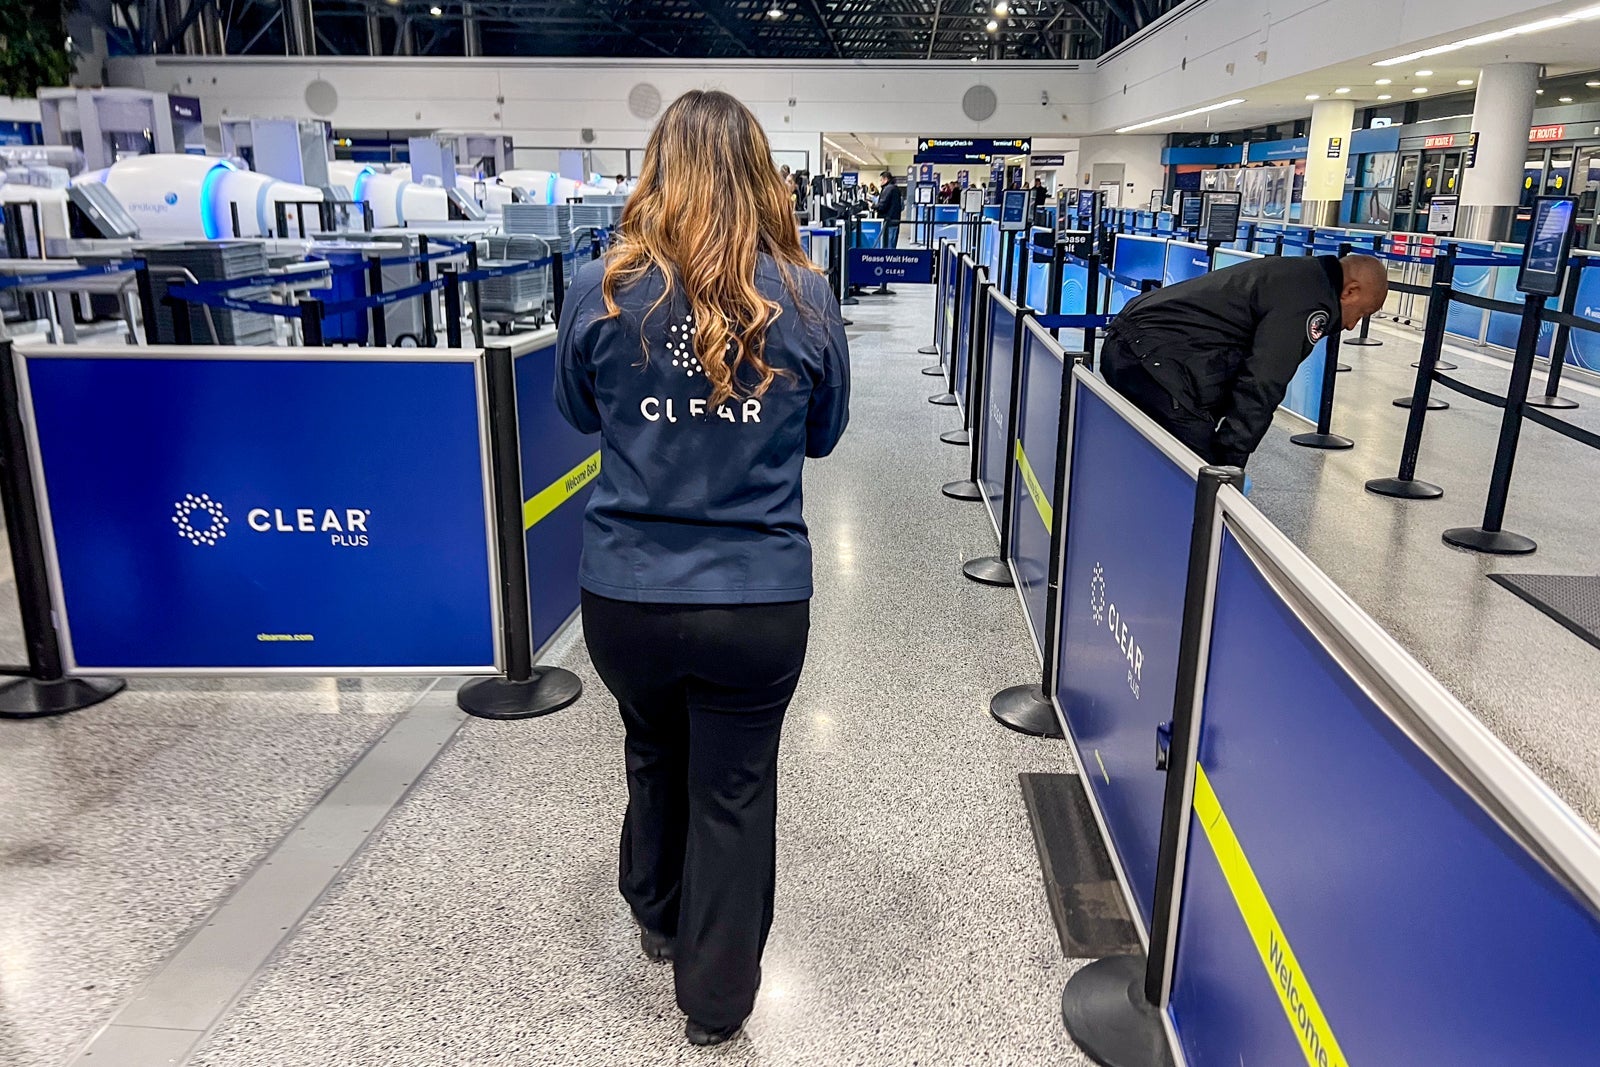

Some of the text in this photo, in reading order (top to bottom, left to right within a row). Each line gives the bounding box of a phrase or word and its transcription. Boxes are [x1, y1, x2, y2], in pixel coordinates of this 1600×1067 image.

[1425, 136, 1449, 147] EXIT ROUTE
[1537, 128, 1557, 139] ROUTE
[1064, 243, 1075, 252] ait
[861, 254, 919, 263] Please Wait Here
[564, 459, 598, 493] Welcome Back
[247, 508, 370, 532] CLEAR
[331, 534, 369, 547] PLUS
[1108, 603, 1144, 681] CLEAR
[1127, 669, 1140, 700] PLUS
[1269, 929, 1328, 1067] Welcome
